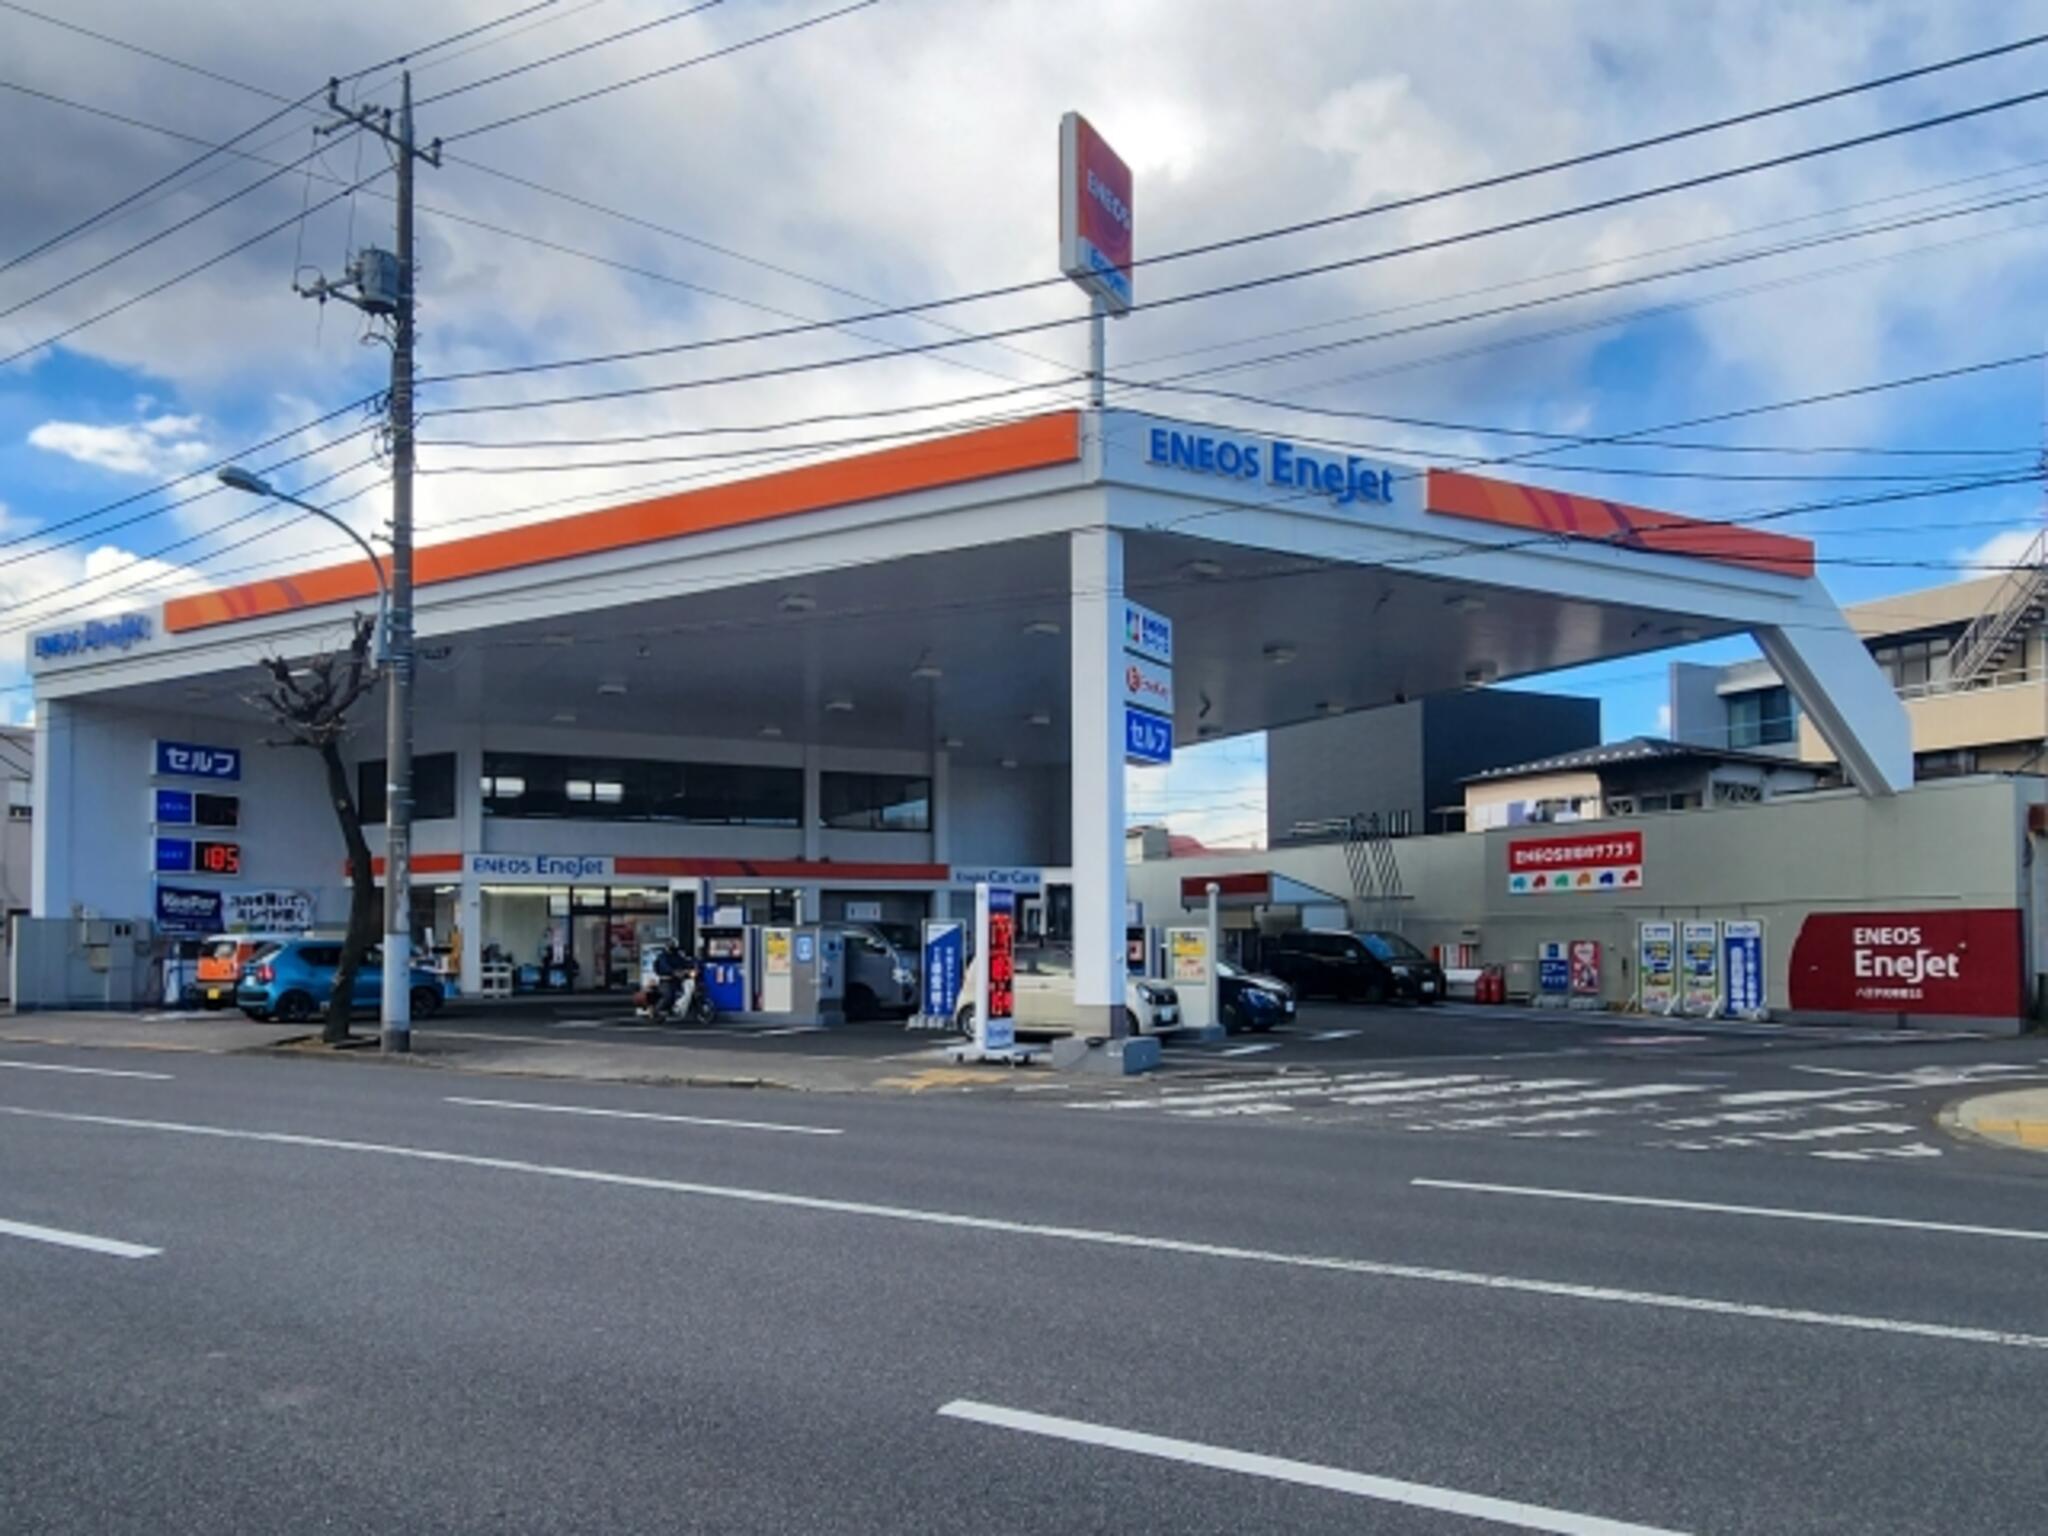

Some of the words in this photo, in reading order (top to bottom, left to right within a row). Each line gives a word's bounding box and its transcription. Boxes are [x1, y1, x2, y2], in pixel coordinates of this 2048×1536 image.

[1087, 168, 1131, 231] ENEOS
[1150, 428, 1261, 479] ENEOS
[1130, 719, 1169, 752] セルフ
[166, 747, 235, 775] セルフ
[204, 845, 239, 871] 185
[473, 857, 531, 875] ENEOS
[1854, 926, 1921, 945] ENEOS
